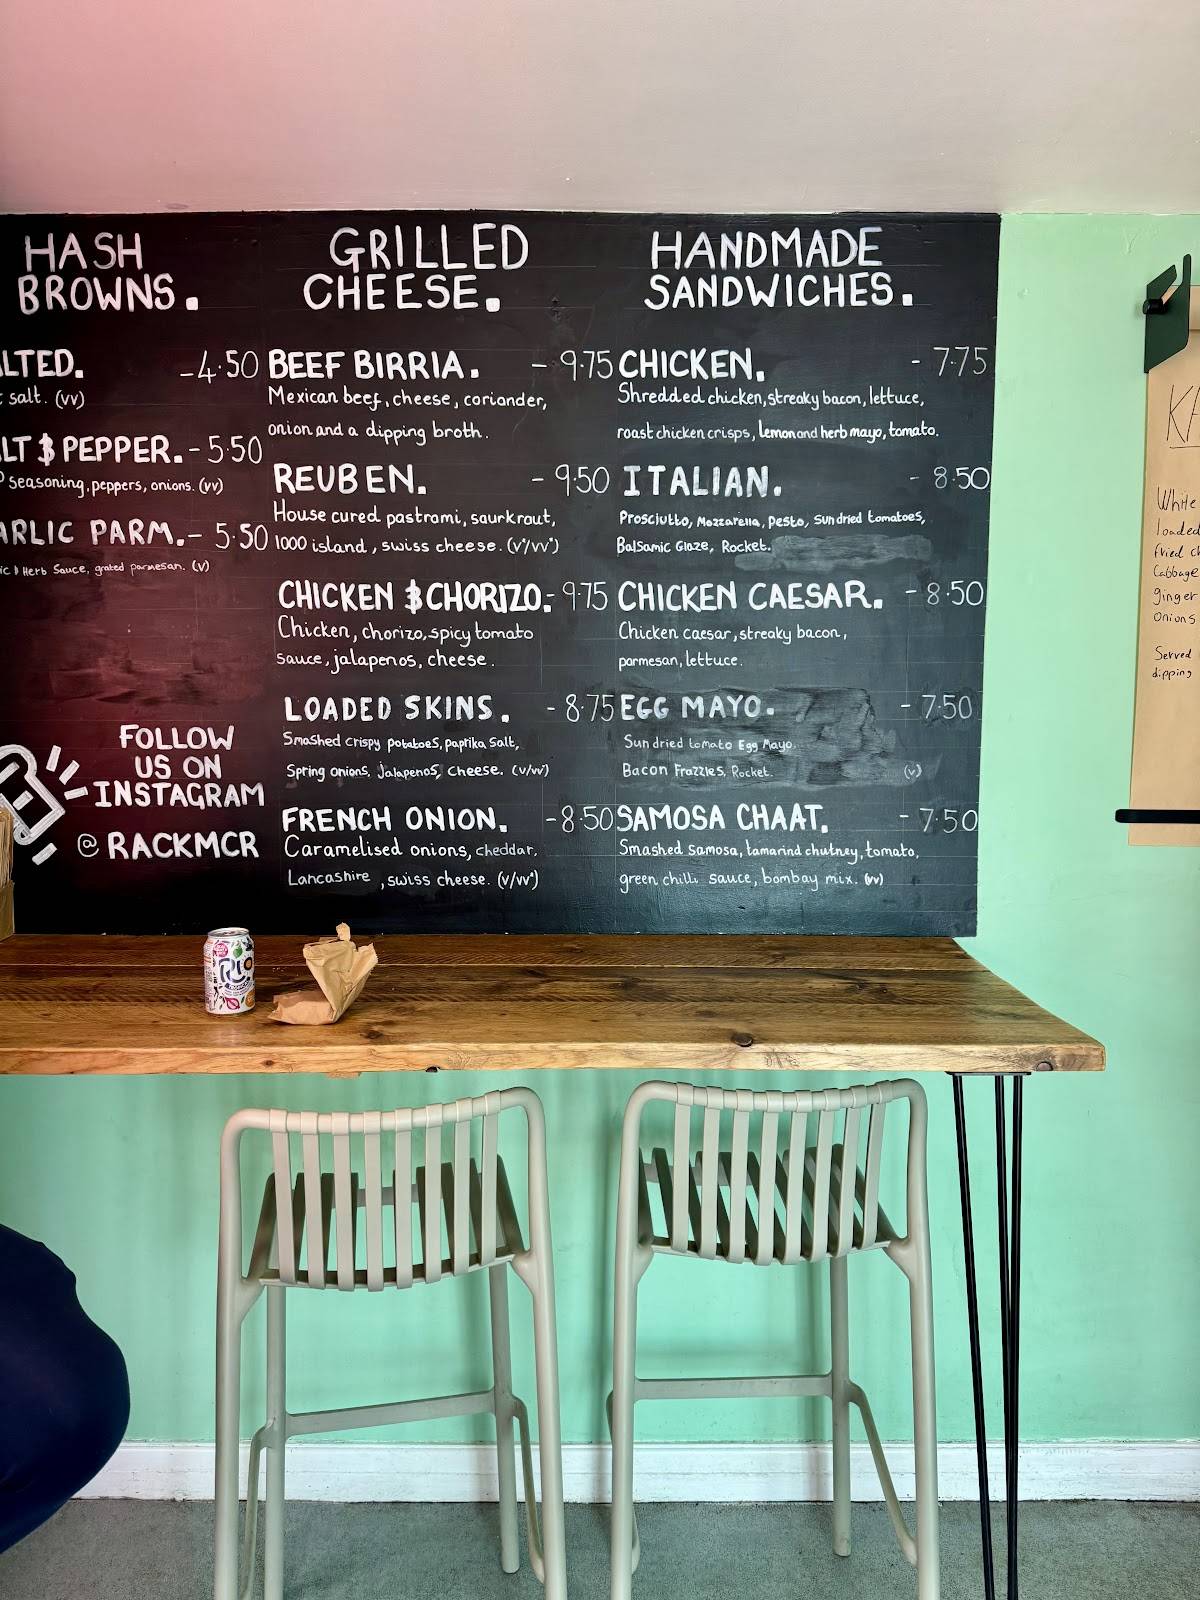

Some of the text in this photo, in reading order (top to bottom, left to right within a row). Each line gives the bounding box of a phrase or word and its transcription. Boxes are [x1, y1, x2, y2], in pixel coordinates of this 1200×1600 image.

[24, 231, 144, 273] HASH
[329, 222, 529, 274] GRILLED
[650, 226, 883, 271] HANDMADE
[17, 272, 199, 316] BROWNS.
[302, 272, 501, 313] CHEESE.
[643, 271, 914, 311] SANDWICHES.
[0, 348, 84, 379] LTED.
[268, 348, 346, 380] BEEF
[353, 349, 480, 381] BIRRIA.
[618, 347, 765, 383] CHICKEN.
[8, 384, 48, 406] salt.
[268, 384, 339, 406] Mexican
[392, 388, 459, 410] cheese,
[463, 391, 547, 411] coriander,
[617, 381, 706, 404] Shredded
[822, 389, 867, 408] bacon,
[869, 384, 925, 407] lettuce,
[347, 426, 359, 437] a
[365, 419, 427, 447] dipping
[431, 419, 489, 439] broth.
[616, 421, 654, 440] roast
[655, 424, 706, 440] chicken
[820, 423, 849, 440] herb
[887, 419, 940, 438] tomato.
[62, 434, 183, 464] PEPPER.
[150, 481, 195, 492] onions.
[273, 462, 427, 495] REUBEN.
[623, 464, 782, 498] ITALIAN.
[273, 499, 556, 530] House cured pastrami, saurkraut,
[619, 509, 694, 530] Prosciutto,
[867, 509, 926, 526] tomatoes,
[89, 517, 185, 547] PARM.
[274, 534, 308, 551] 1000
[381, 538, 430, 553] swiss
[435, 536, 503, 553] cheese.
[721, 538, 772, 554] Rocket.
[278, 579, 394, 613] CHICKEN
[617, 580, 738, 613] CHICKEN
[748, 579, 884, 611] CAESAR.
[277, 614, 358, 644] Chicken,
[474, 620, 534, 640] tomato
[618, 620, 680, 641] Chicken
[739, 625, 792, 645] streaky
[796, 624, 847, 641] bacon,
[276, 652, 330, 667] sauce,
[427, 648, 495, 668] cheese.
[686, 649, 743, 667] lettuce.
[1154, 645, 1192, 661] Served
[1152, 666, 1192, 681] dipping
[284, 695, 392, 722] LOADED
[404, 694, 510, 724] SKINS.
[620, 693, 670, 721] EGG
[681, 694, 775, 719] MAYO.
[118, 723, 235, 751] FOLLOW
[282, 730, 342, 748] Smashed
[652, 736, 684, 749] dried
[737, 739, 759, 754] Egg
[134, 753, 222, 780] US ON
[622, 762, 669, 778] Bacon
[92, 779, 265, 811] INSTAGRAM
[281, 805, 392, 833] FRENCH
[405, 805, 508, 833] ONION.
[616, 804, 726, 832] SAMOSA
[736, 802, 829, 834] CHAAT.
[107, 830, 260, 861] RACKMCR
[284, 833, 404, 858] Caramelised
[409, 844, 472, 862] onions,
[617, 838, 684, 857] Smashed
[745, 838, 803, 857] tamarind
[804, 842, 864, 866] chutney,
[864, 839, 920, 860] tomato,
[287, 868, 491, 887] Lancashire cheese.
[618, 873, 659, 894] green
[708, 873, 758, 887] sauce,
[761, 868, 819, 892] bombay
[825, 874, 859, 885] mix.
